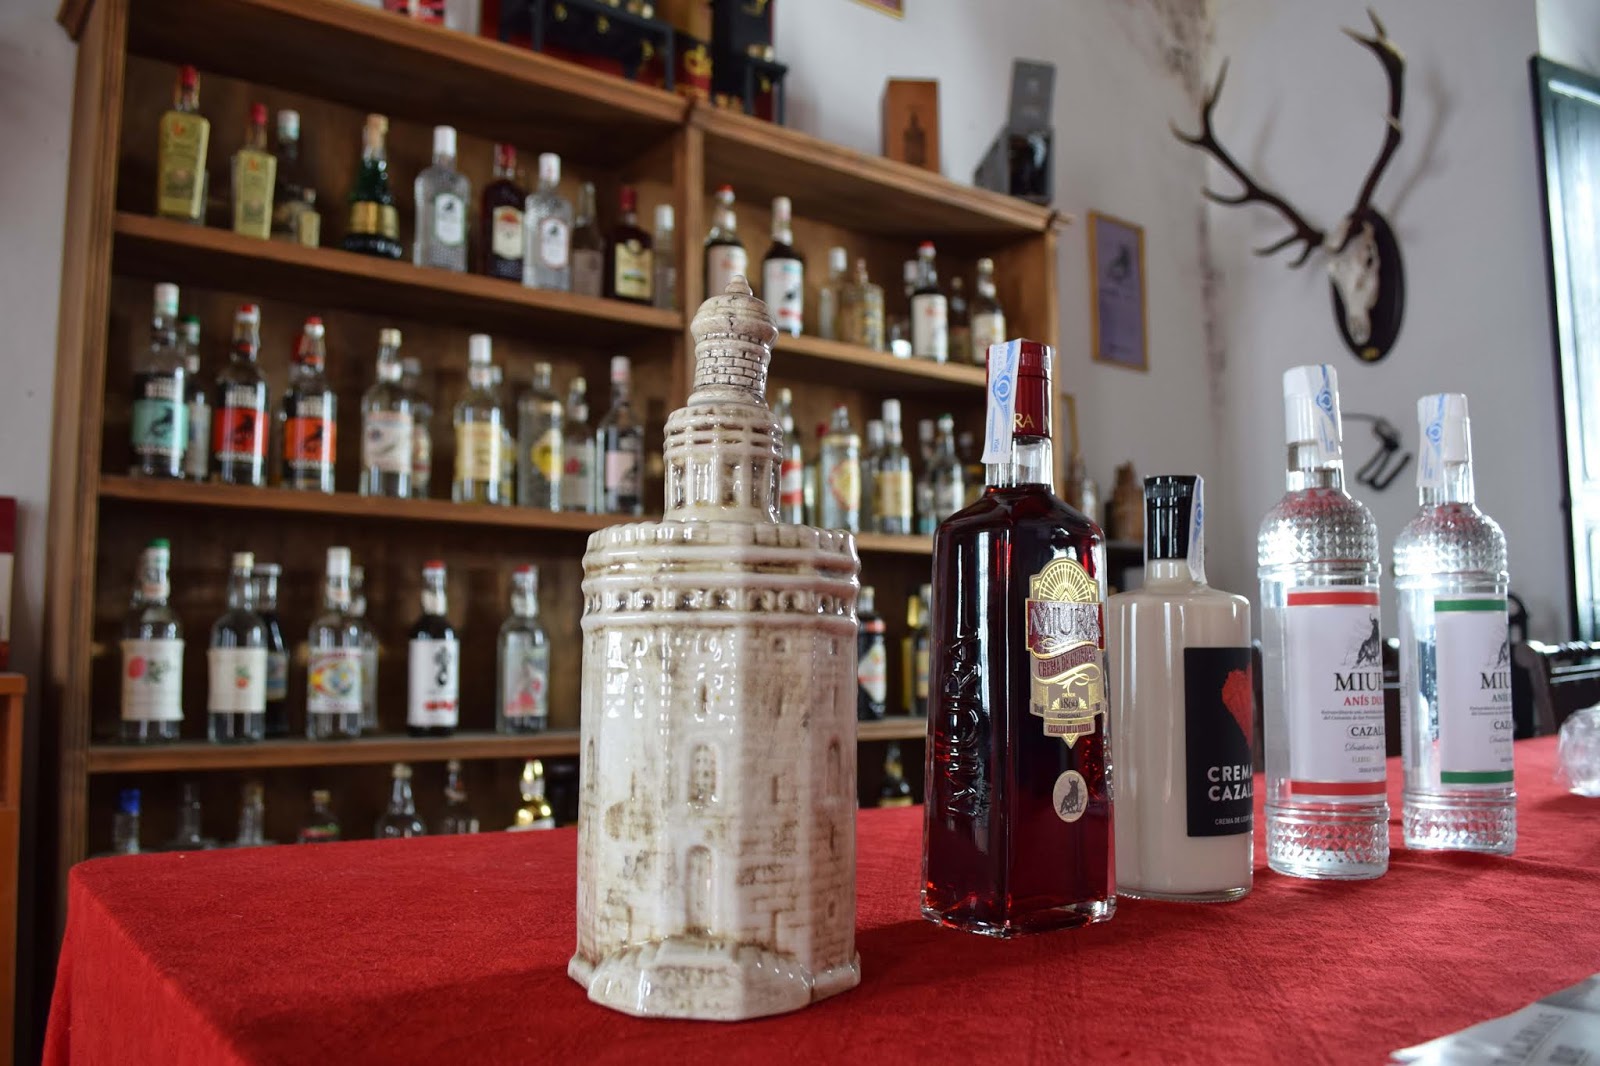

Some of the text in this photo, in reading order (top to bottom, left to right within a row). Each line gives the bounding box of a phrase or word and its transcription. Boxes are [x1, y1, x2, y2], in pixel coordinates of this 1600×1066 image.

[1014, 413, 1035, 428] RA
[1029, 607, 1101, 636] MIURA
[1038, 659, 1061, 677] CREMA
[1344, 694, 1369, 706] ANÍS
